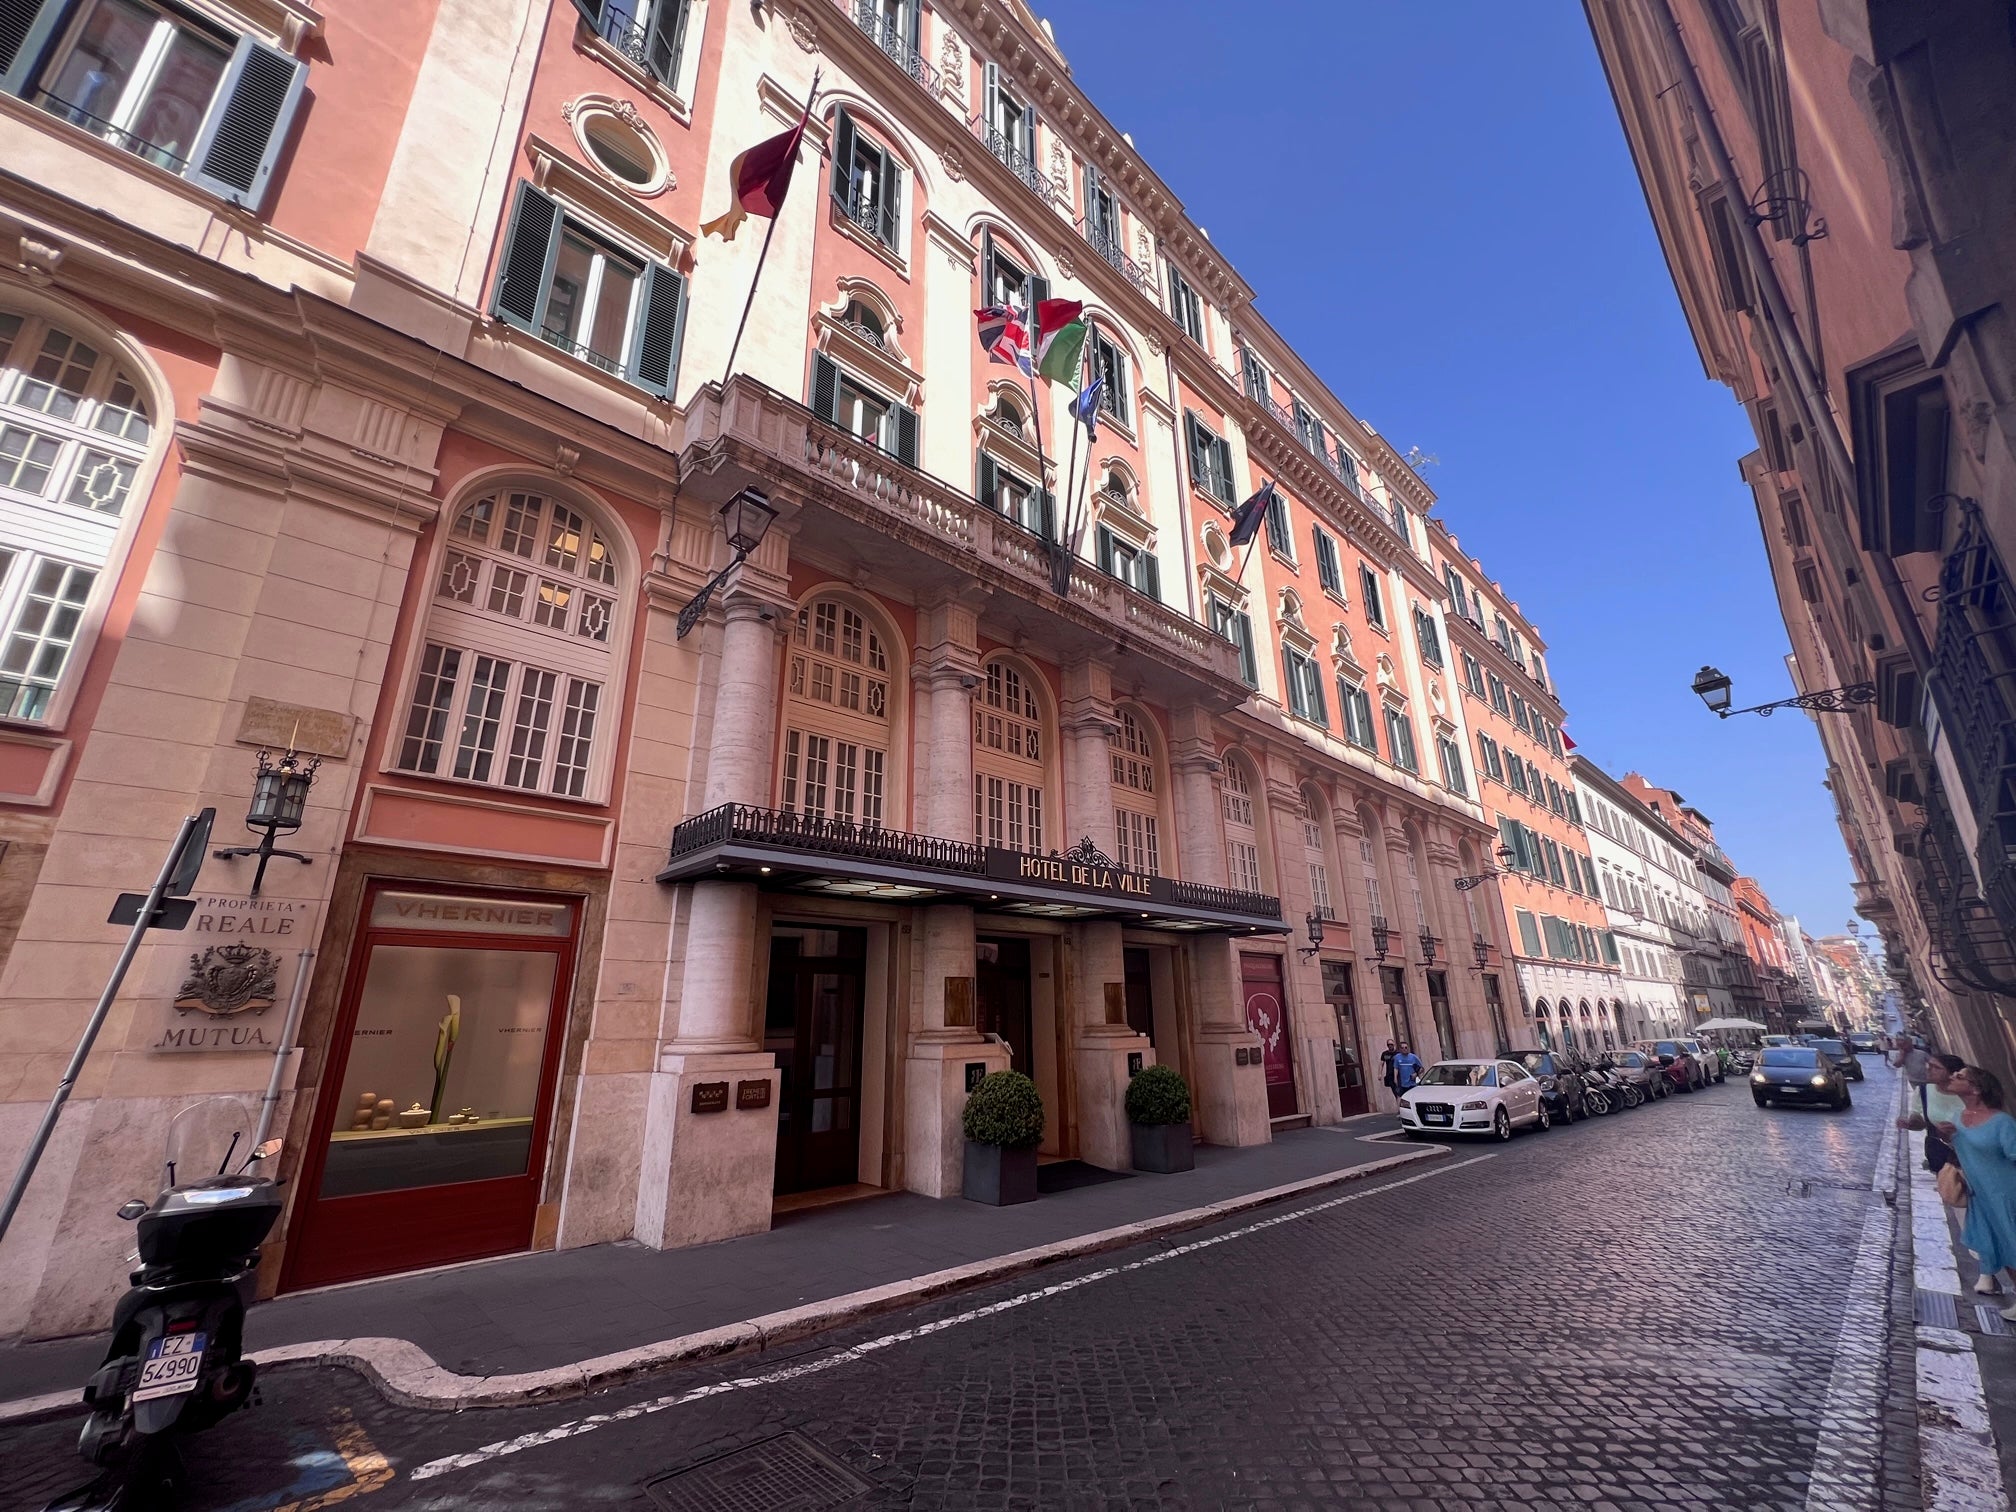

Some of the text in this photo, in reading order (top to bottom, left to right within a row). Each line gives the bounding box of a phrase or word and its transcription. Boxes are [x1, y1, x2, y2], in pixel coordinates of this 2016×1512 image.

[1020, 856, 1151, 895] HOTEL DE LA VILLE
[208, 897, 293, 912] PROPRIETA
[395, 902, 553, 926] VHERNIER
[195, 914, 295, 935] REALE
[160, 1027, 267, 1047] MUTUA
[162, 1336, 185, 1356] EZ
[142, 1356, 199, 1383] 54990
